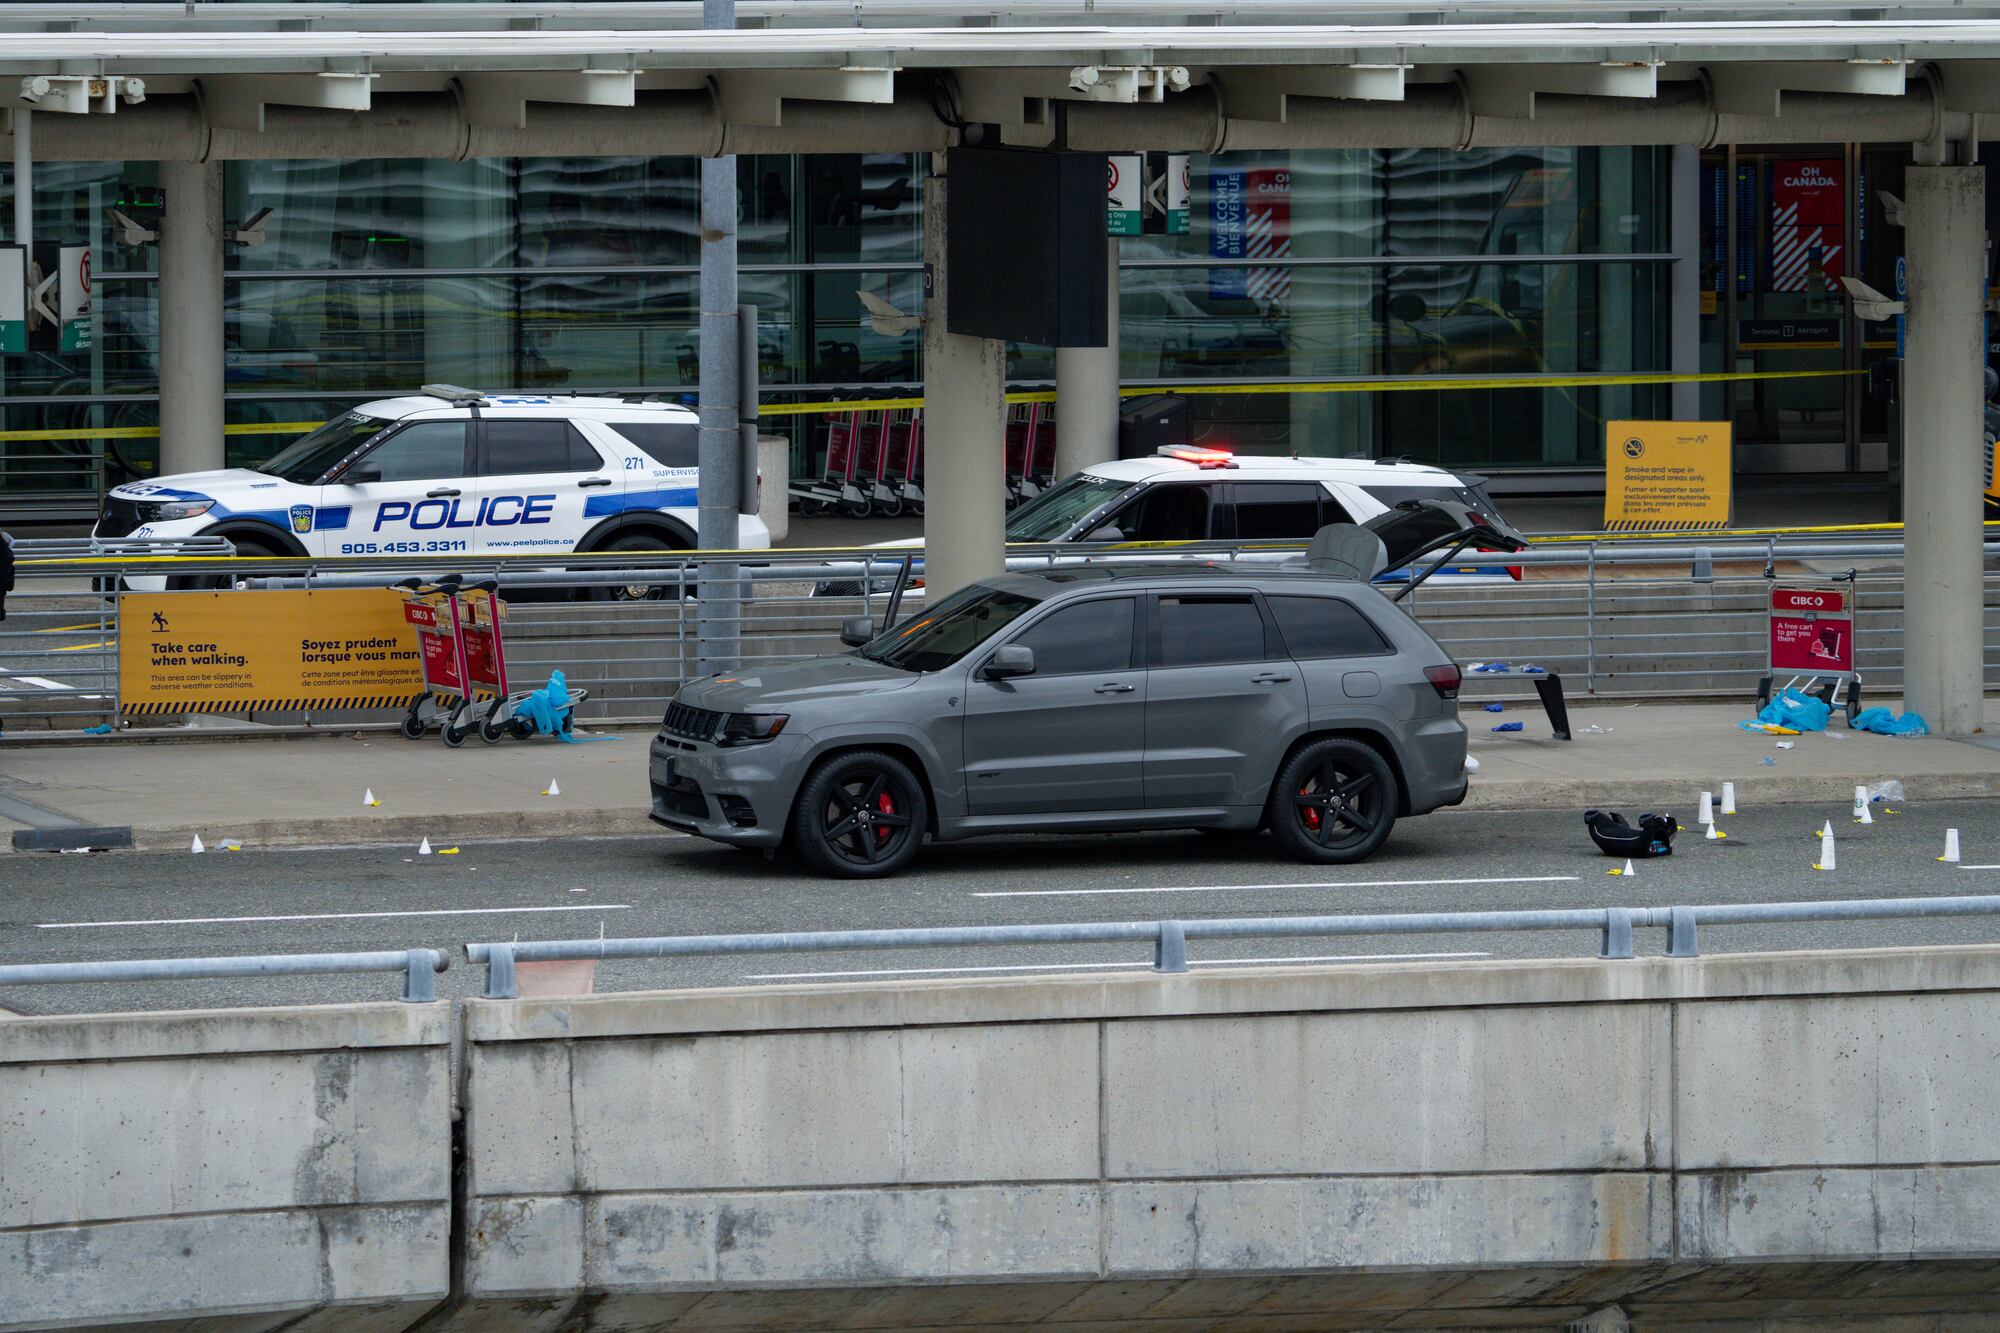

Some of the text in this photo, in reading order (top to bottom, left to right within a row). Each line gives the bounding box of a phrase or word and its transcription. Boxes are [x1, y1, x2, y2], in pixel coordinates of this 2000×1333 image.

[1801, 166, 1820, 177] OH
[1783, 176, 1838, 187] CANADA.
[1257, 183, 1291, 193] CANA
[1216, 178, 1228, 250] WELCOME
[1228, 173, 1241, 254] BIENVENUE
[1751, 327, 1780, 335] Terminal
[625, 457, 644, 469] 271
[1667, 467, 1686, 475] vape
[1624, 474, 1666, 482] designated
[1689, 474, 1706, 482] only.
[1658, 487, 1688, 495] vapoter
[372, 494, 557, 533] POLICE
[138, 526, 154, 538] 271
[341, 540, 467, 555] 905.453.3311
[486, 538, 575, 548] www.peelpolice.ca
[1790, 596, 1814, 606] CIBC
[1786, 629, 1797, 637] get
[1777, 635, 1796, 643] there
[151, 642, 217, 653] Take care
[301, 637, 398, 653] Soyez prudent
[151, 653, 249, 667] when walking.
[301, 652, 351, 665] lorsque
[355, 652, 386, 661] vous
[201, 673, 212, 681] be
[213, 673, 243, 682] slippery
[342, 671, 359, 679] peut
[360, 669, 375, 677] être
[376, 669, 409, 678] glissante
[150, 681, 254, 691] adverse weather conditions.
